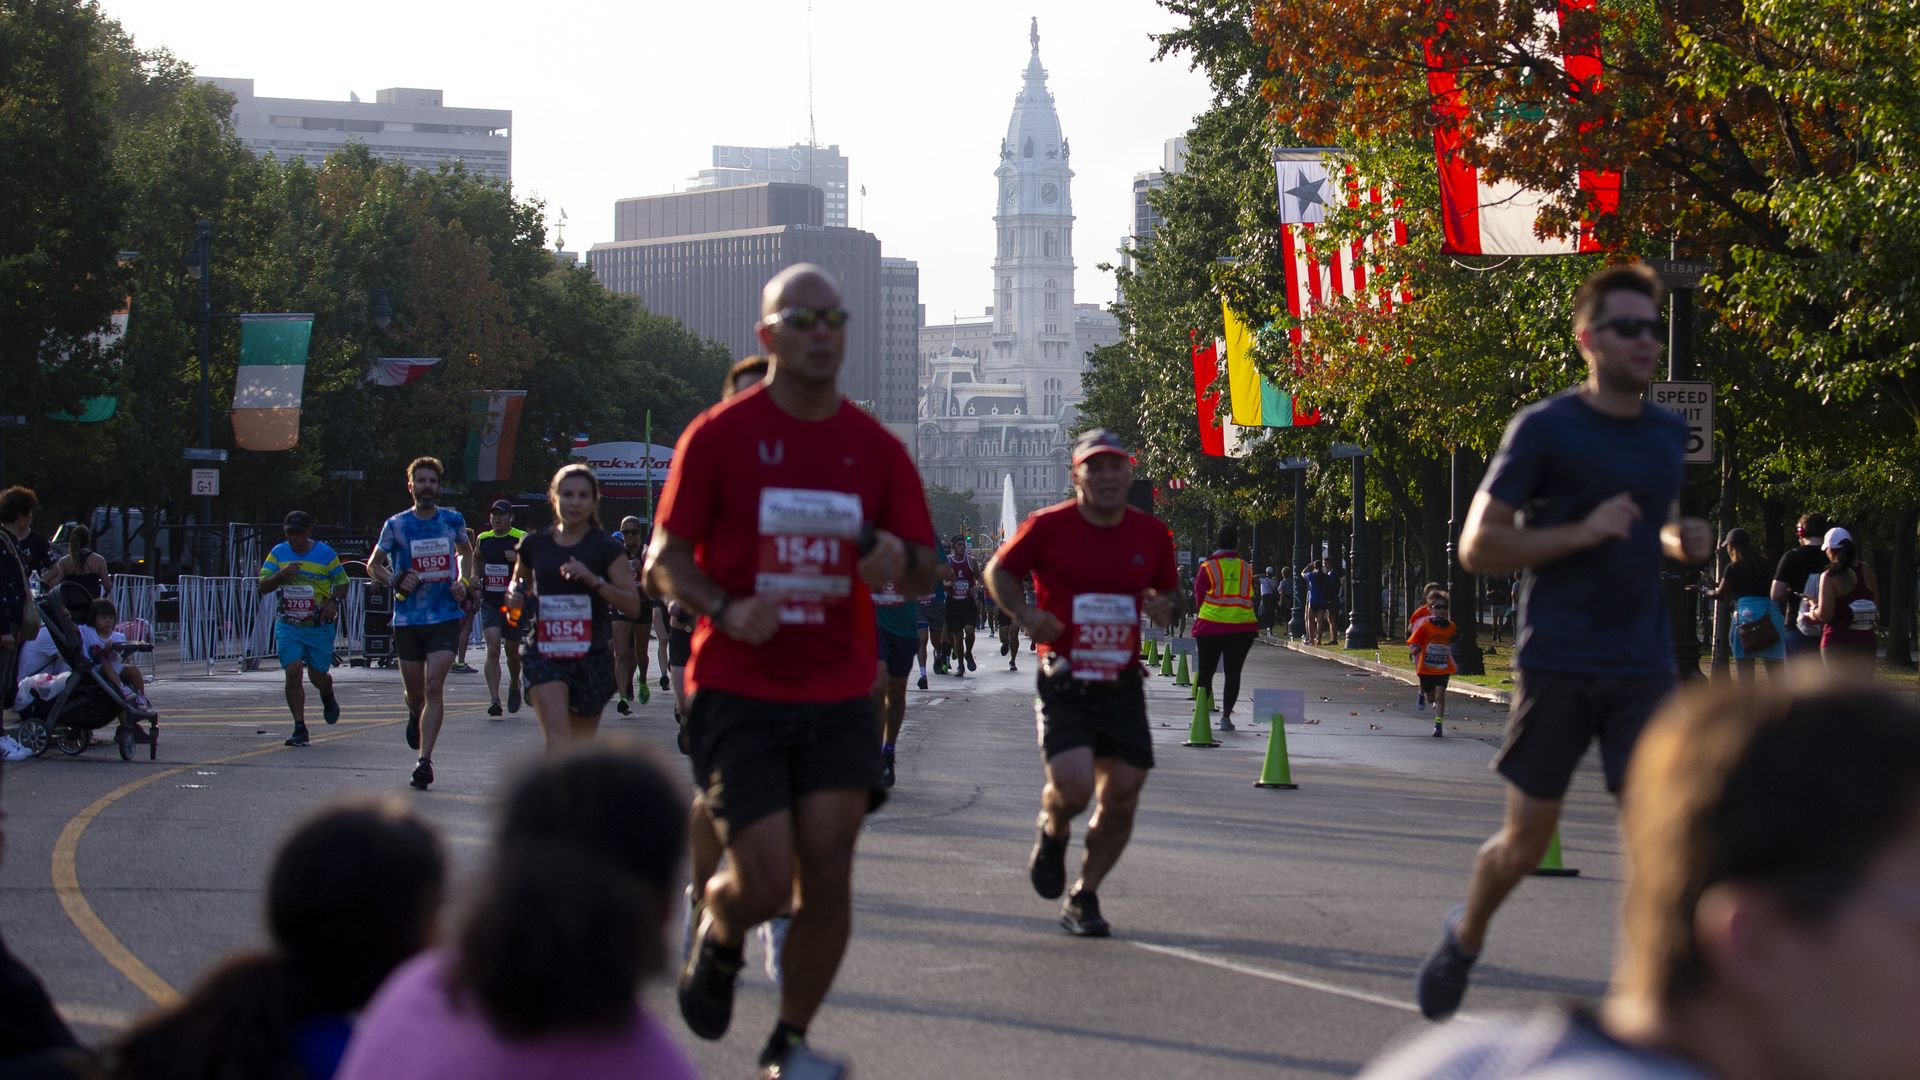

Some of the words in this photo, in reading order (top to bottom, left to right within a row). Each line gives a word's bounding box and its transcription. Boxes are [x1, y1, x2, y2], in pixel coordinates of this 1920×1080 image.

[718, 146, 802, 172] PSFS
[1664, 262, 1712, 274] LEBANO
[1657, 391, 1708, 404] SPEED
[1671, 408, 1703, 420] IMIT
[1686, 426, 1704, 454] 5
[197, 481, 212, 492] G-1
[774, 536, 839, 565] 1541
[416, 556, 446, 568] 1650
[288, 600, 311, 608] 2769
[545, 621, 584, 636] 1654
[1079, 625, 1132, 644] 2037
